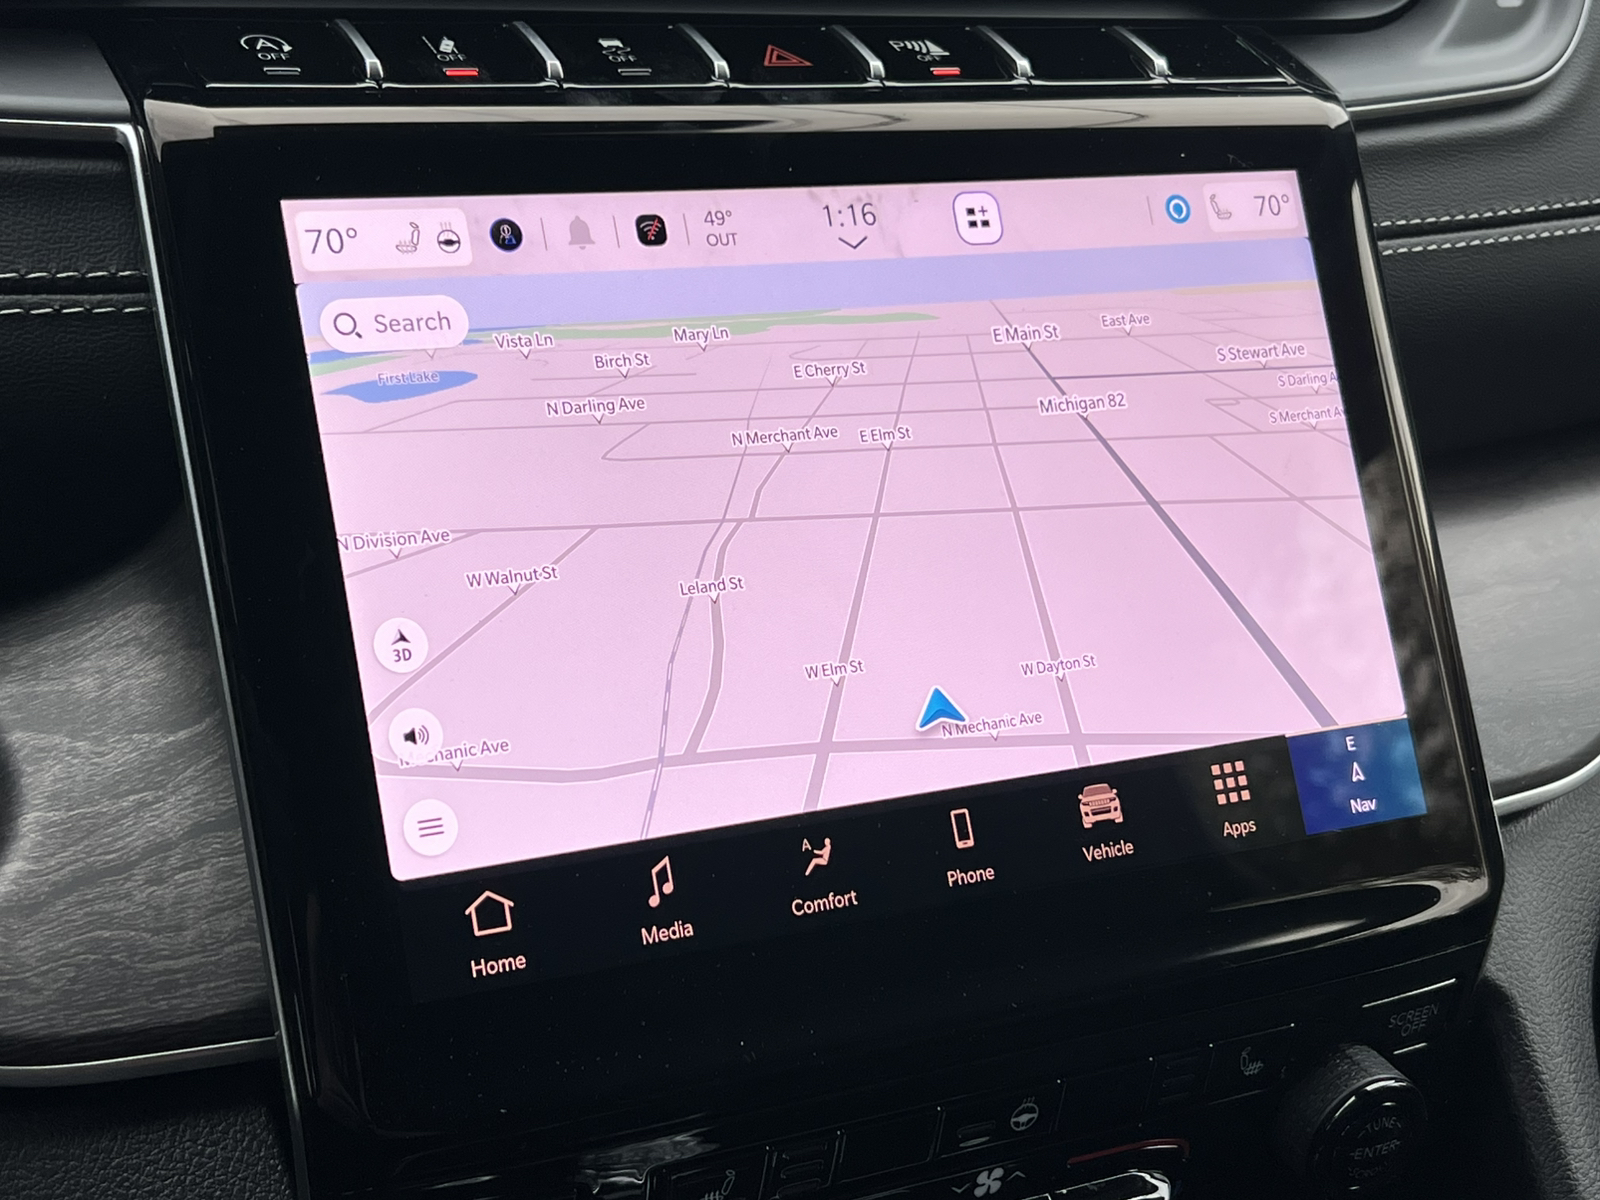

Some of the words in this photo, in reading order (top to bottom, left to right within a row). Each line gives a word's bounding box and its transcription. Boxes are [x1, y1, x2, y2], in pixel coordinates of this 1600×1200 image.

[257, 52, 290, 61] OFF
[437, 53, 466, 62] OFF
[609, 54, 637, 63] OFF
[1254, 194, 1290, 217] 70°
[704, 210, 732, 226] 49°
[822, 202, 877, 228] 1:16
[305, 227, 357, 254] 70°
[706, 232, 738, 247] OUT
[374, 311, 451, 334] Search
[1101, 315, 1126, 328] East
[1128, 313, 1151, 326] Ave
[495, 335, 532, 350] Vista
[536, 334, 554, 347] Ln
[673, 328, 710, 344] Mary
[712, 327, 730, 340] Ln
[992, 329, 1002, 343] E
[1005, 327, 1041, 342] Main
[1044, 326, 1060, 340] St
[1217, 348, 1226, 361] S
[1229, 344, 1279, 361] Stewart
[1281, 343, 1305, 358] Ave
[594, 354, 635, 370] Birch
[637, 353, 651, 367] St
[793, 365, 802, 379] E
[804, 362, 850, 379] Cherry
[852, 361, 866, 375] St
[377, 372, 407, 385] First
[409, 371, 440, 384] Lake
[1278, 375, 1286, 388] S
[1288, 371, 1328, 388] Darling
[546, 401, 559, 416] N
[562, 399, 615, 416] Darling
[618, 397, 646, 411] Ave
[1038, 396, 1105, 415] Michigan
[1108, 394, 1126, 409] 82
[1269, 411, 1277, 424] S
[1279, 407, 1332, 423] Merchant
[732, 433, 743, 447] N
[746, 428, 811, 444] Merchant
[813, 426, 839, 440] Ave
[859, 430, 868, 443] E
[871, 429, 895, 442] Elm
[897, 427, 912, 440] St
[353, 531, 418, 550] Division
[420, 529, 451, 545] Ave
[466, 574, 482, 588] W
[484, 567, 540, 587] Walnut
[541, 565, 559, 580] St
[679, 578, 727, 596] Leland
[729, 576, 744, 591] St
[392, 648, 412, 663] 3D
[805, 666, 819, 680] W
[822, 662, 847, 677] Elm
[849, 659, 864, 673] St
[1021, 663, 1034, 677] W
[1036, 659, 1081, 674] Dayton
[1082, 655, 1096, 669] St
[942, 724, 953, 738] N
[955, 716, 1016, 735] Mechanic
[1018, 712, 1043, 726] Ave
[480, 740, 510, 755] Ave
[1346, 735, 1357, 751] E
[1350, 796, 1377, 814] Nav
[1223, 817, 1257, 838] Apps
[801, 838, 812, 852] A
[1082, 839, 1135, 863] Vehicle
[946, 864, 995, 888] Phone
[791, 889, 859, 917] Comfort
[640, 920, 695, 946] Media
[470, 953, 527, 979] Home
[1388, 1004, 1440, 1028] SCREEN
[1400, 1018, 1428, 1037] OFF
[1366, 1116, 1398, 1133] TUNE
[1354, 1138, 1398, 1160] ENTER
